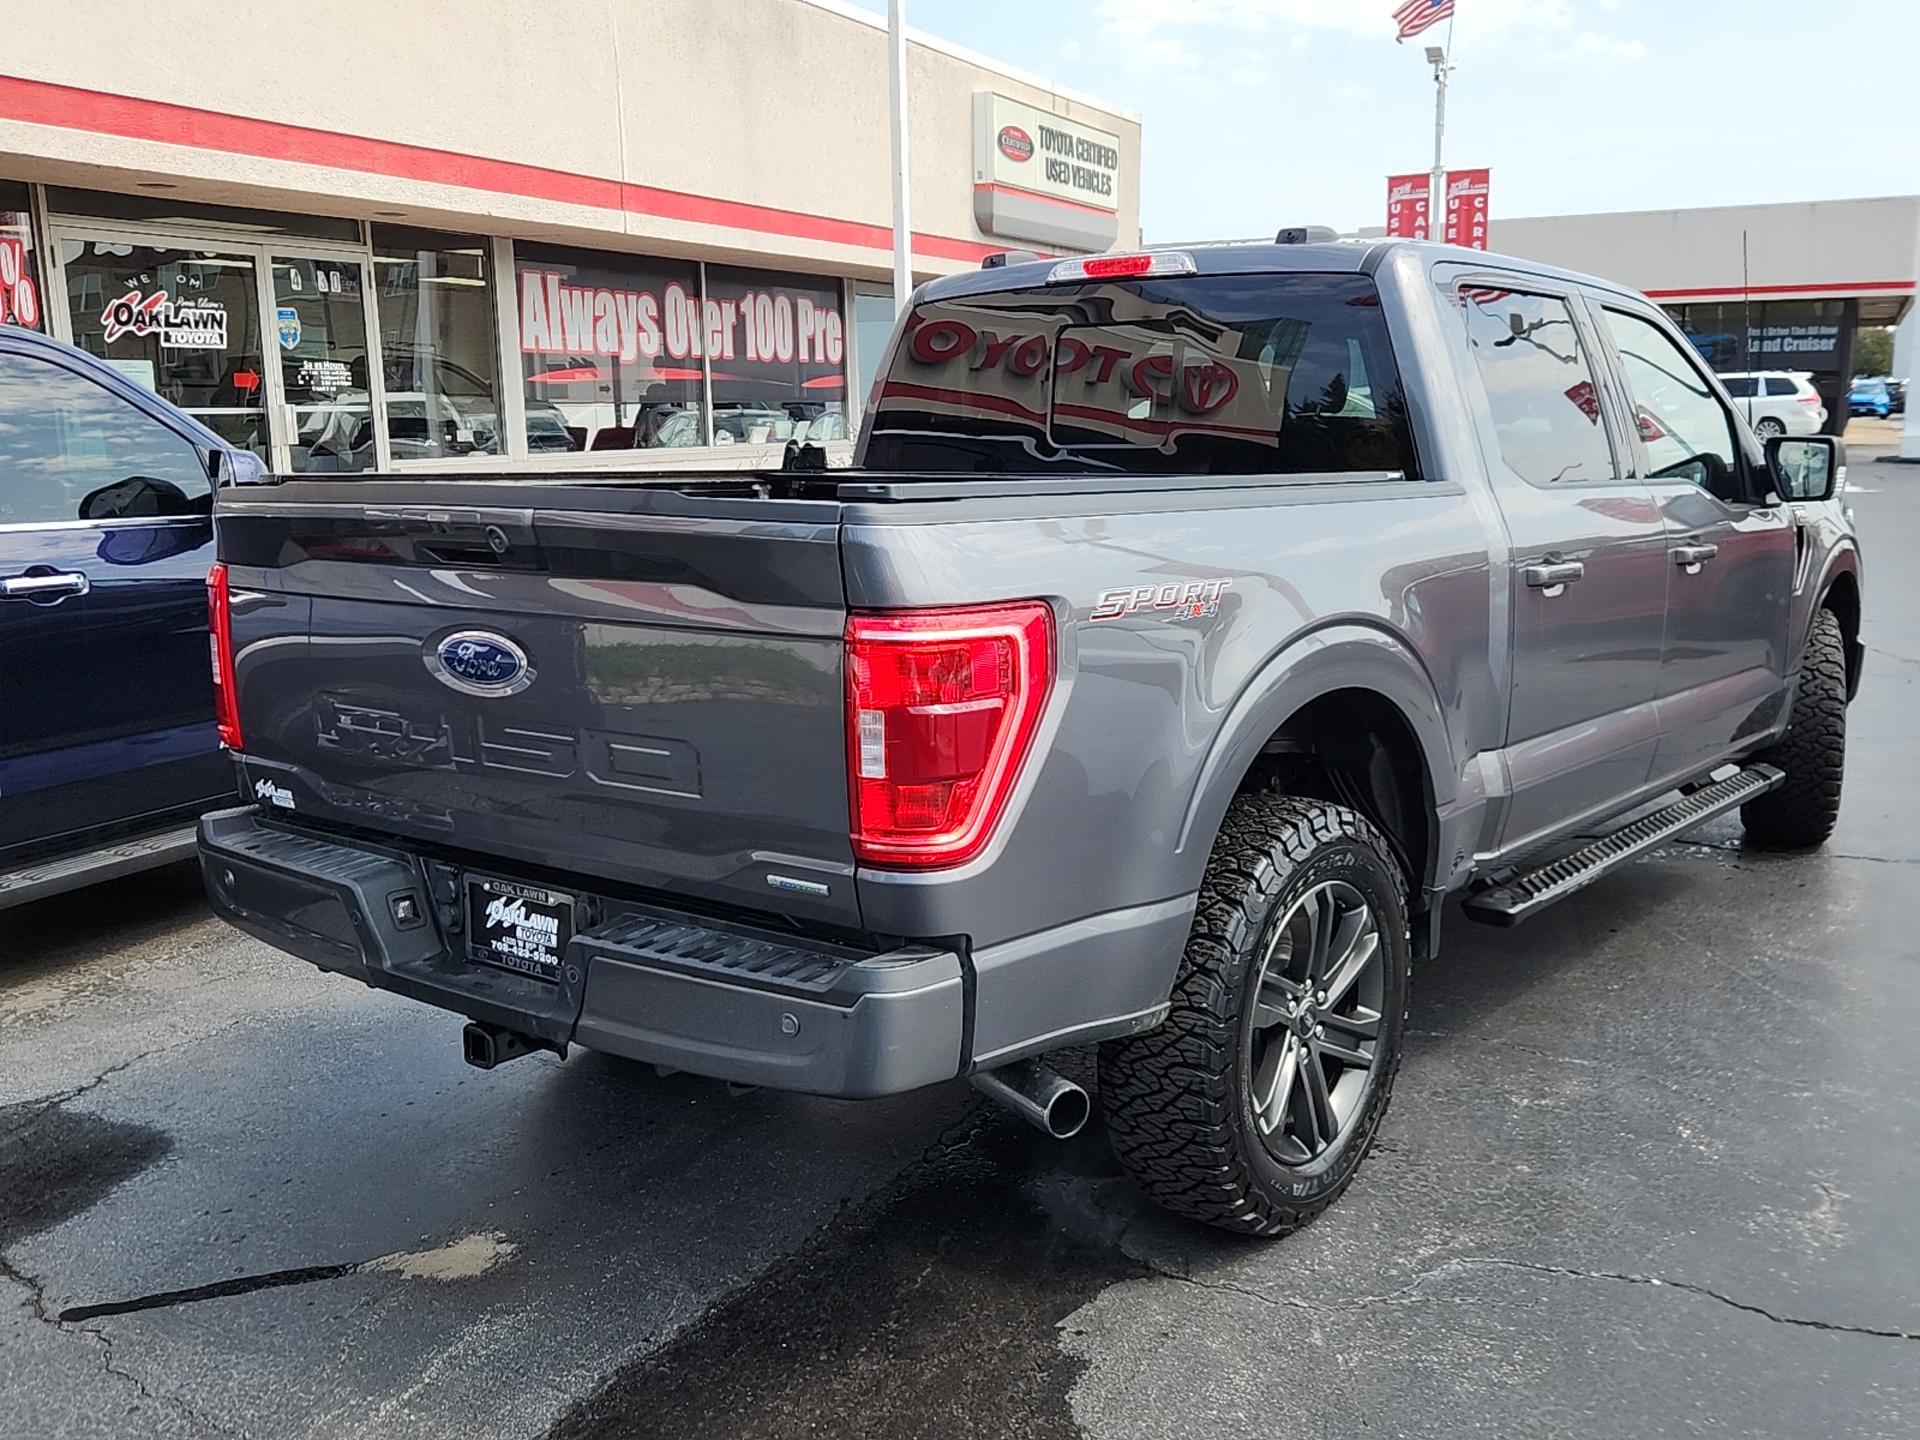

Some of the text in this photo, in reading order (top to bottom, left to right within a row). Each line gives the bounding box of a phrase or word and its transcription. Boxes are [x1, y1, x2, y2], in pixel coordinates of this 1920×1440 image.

[1038, 125, 1118, 171] TOYOTA CERTIFIED
[1045, 157, 1112, 197] USED VEHICLES
[522, 270, 846, 365] Always Over 100 Pre
[169, 332, 221, 345] TOYOTA
[1783, 337, 1836, 351] Cruiser
[1089, 578, 1232, 622] SPORT
[453, 642, 502, 677] Ford
[493, 881, 547, 901] OAK LAWN
[521, 928, 554, 945] TOYOTA
[490, 939, 559, 966] 708-423-5200
[500, 954, 543, 974] TOYOTA
